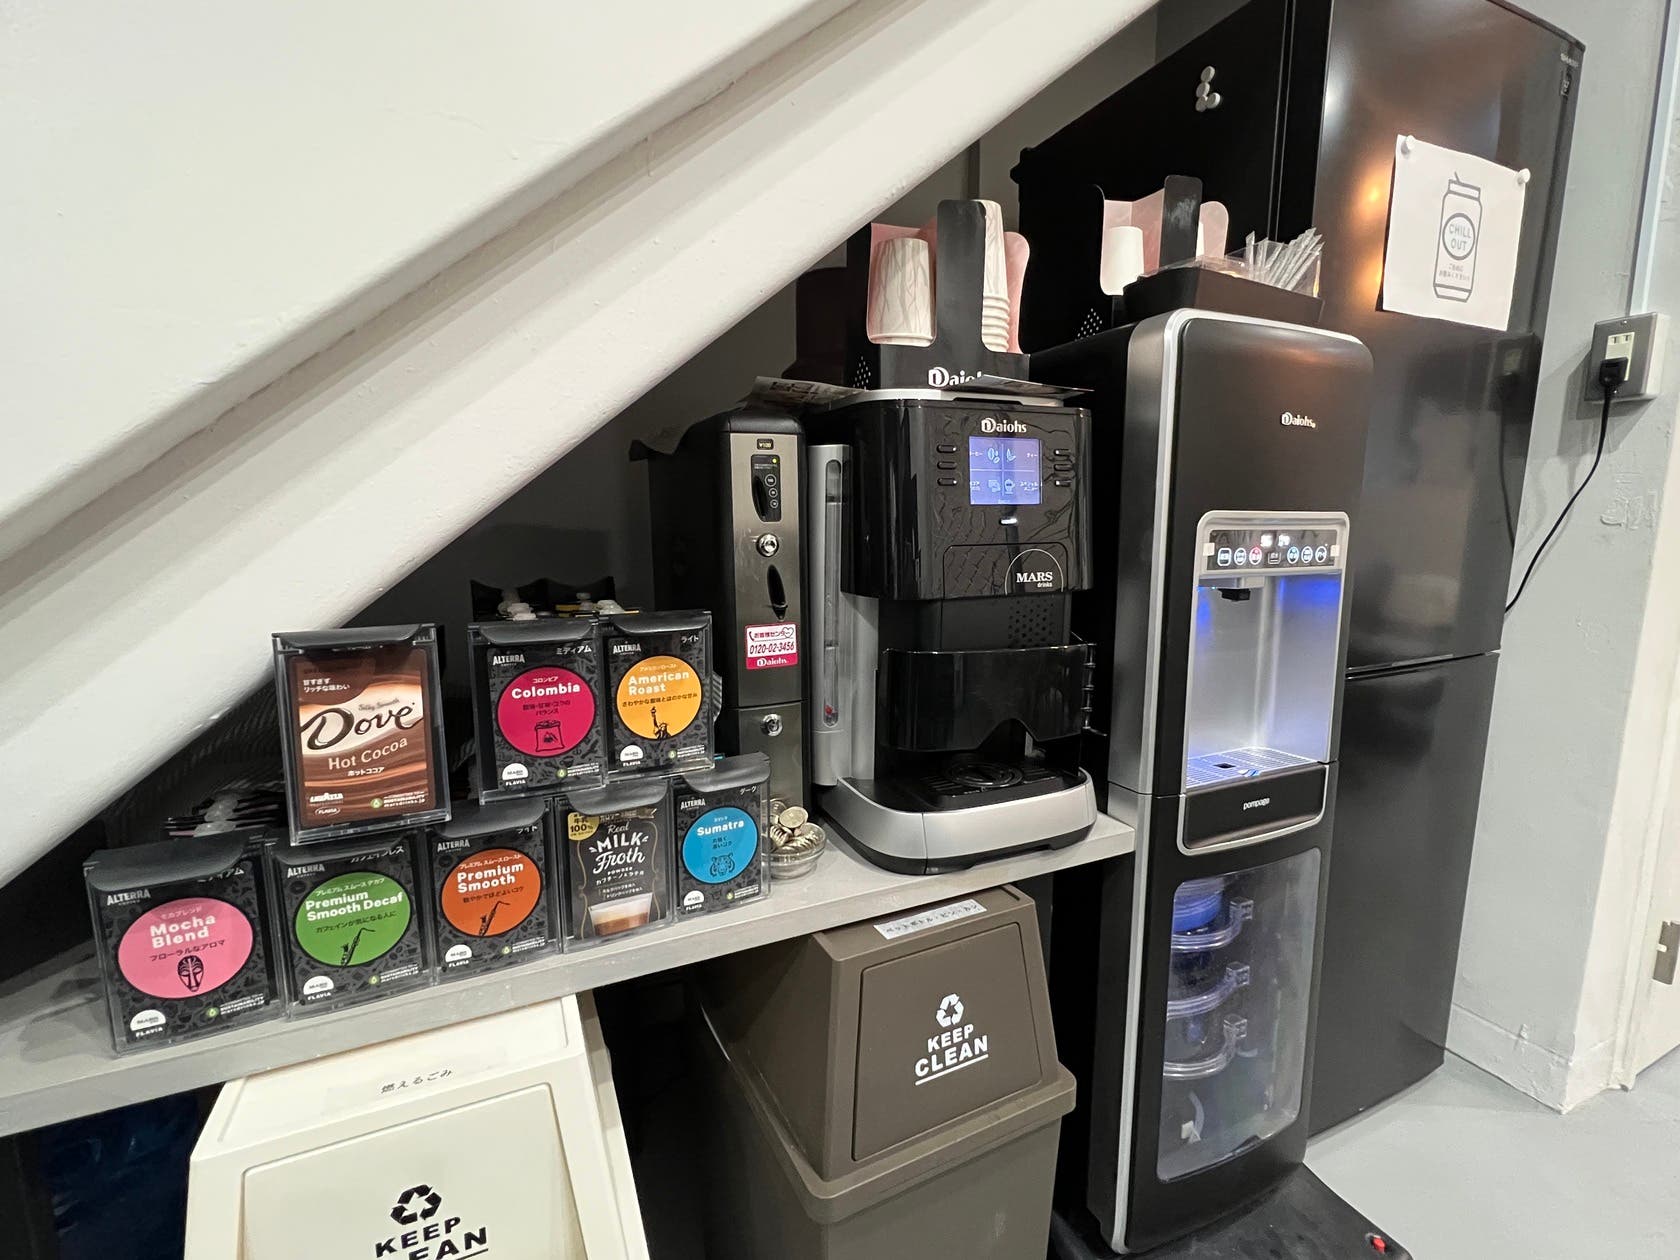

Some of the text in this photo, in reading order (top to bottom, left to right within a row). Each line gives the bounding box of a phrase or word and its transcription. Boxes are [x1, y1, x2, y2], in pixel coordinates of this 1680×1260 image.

[1449, 224, 1471, 239] CHILL
[1450, 238, 1467, 251] OUT
[981, 417, 1027, 433] Daiohs
[1016, 571, 1053, 583] MARS
[613, 642, 642, 654] ALTERRA
[749, 641, 795, 655] 0120-02-3456
[492, 653, 525, 666] ALTERRA
[628, 671, 690, 686] American
[511, 682, 581, 699] Colombia
[628, 682, 667, 696] Roast
[301, 706, 424, 751] Dove
[328, 737, 408, 771] Hot Cocoa
[680, 798, 706, 810] ALTERRA
[696, 820, 745, 836] Sumatra
[437, 839, 470, 853] ALTERRA
[596, 831, 643, 853] MILK
[593, 846, 646, 875] Froth
[287, 863, 325, 879] ALTERRA
[457, 863, 524, 883] Premium
[457, 875, 516, 894] Smooth
[106, 888, 151, 907] ALTERRA
[305, 891, 369, 911] Premium
[307, 892, 403, 921] Smooth Decaf
[150, 914, 217, 938] Mocha
[152, 926, 209, 949] Blend
[927, 1023, 974, 1053] KEEP
[914, 1035, 989, 1077] CLEAN
[381, 1069, 452, 1094] 燃えるごみ
[375, 1217, 461, 1258] KEEP
[408, 1227, 487, 1260] EAN
